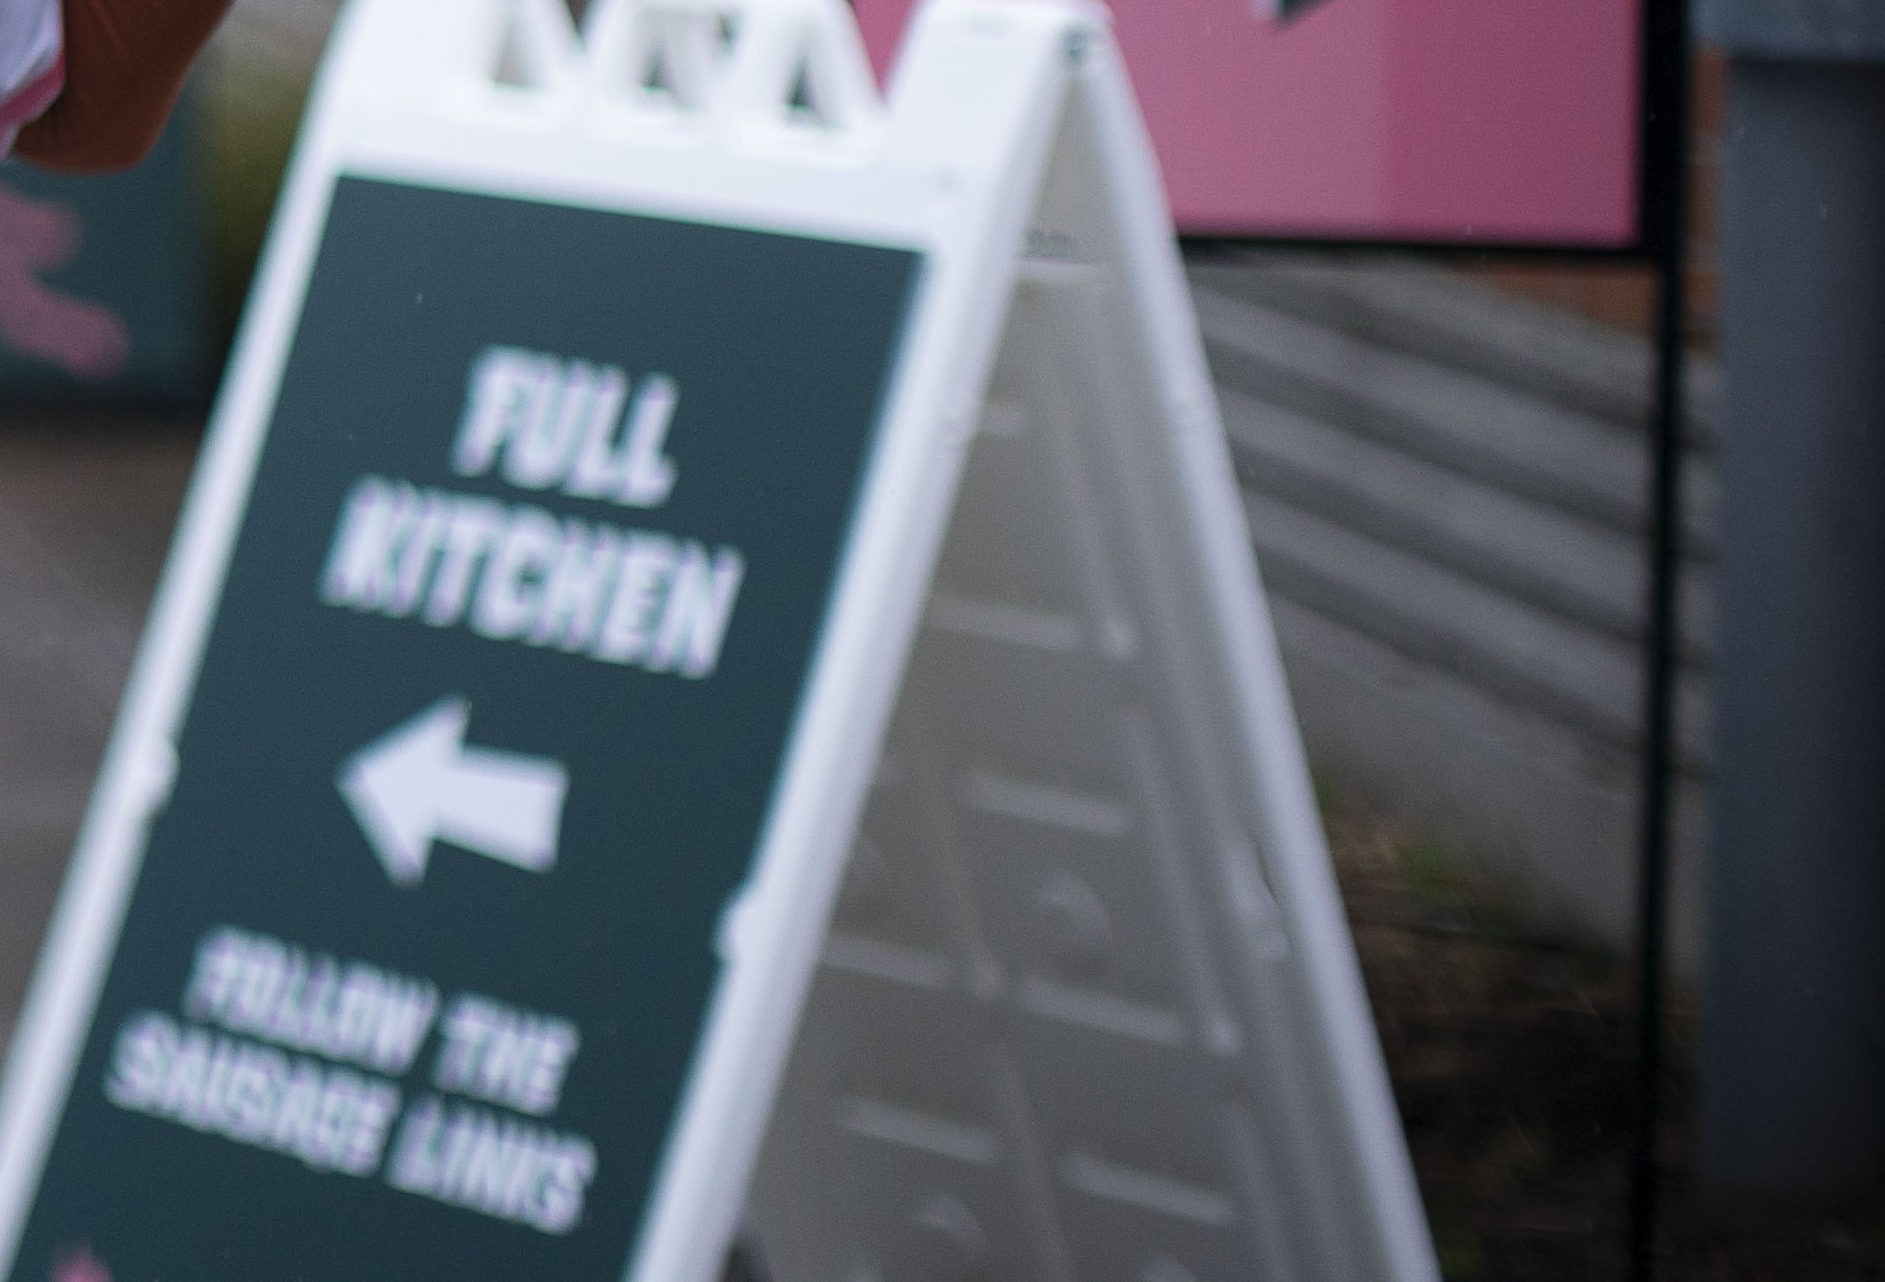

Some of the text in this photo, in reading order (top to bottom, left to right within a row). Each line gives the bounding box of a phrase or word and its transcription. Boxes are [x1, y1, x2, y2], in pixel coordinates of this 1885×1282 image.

[449, 342, 681, 510] FULL
[319, 472, 748, 681] KITCHEN
[181, 922, 582, 1118] FOLLOW THE
